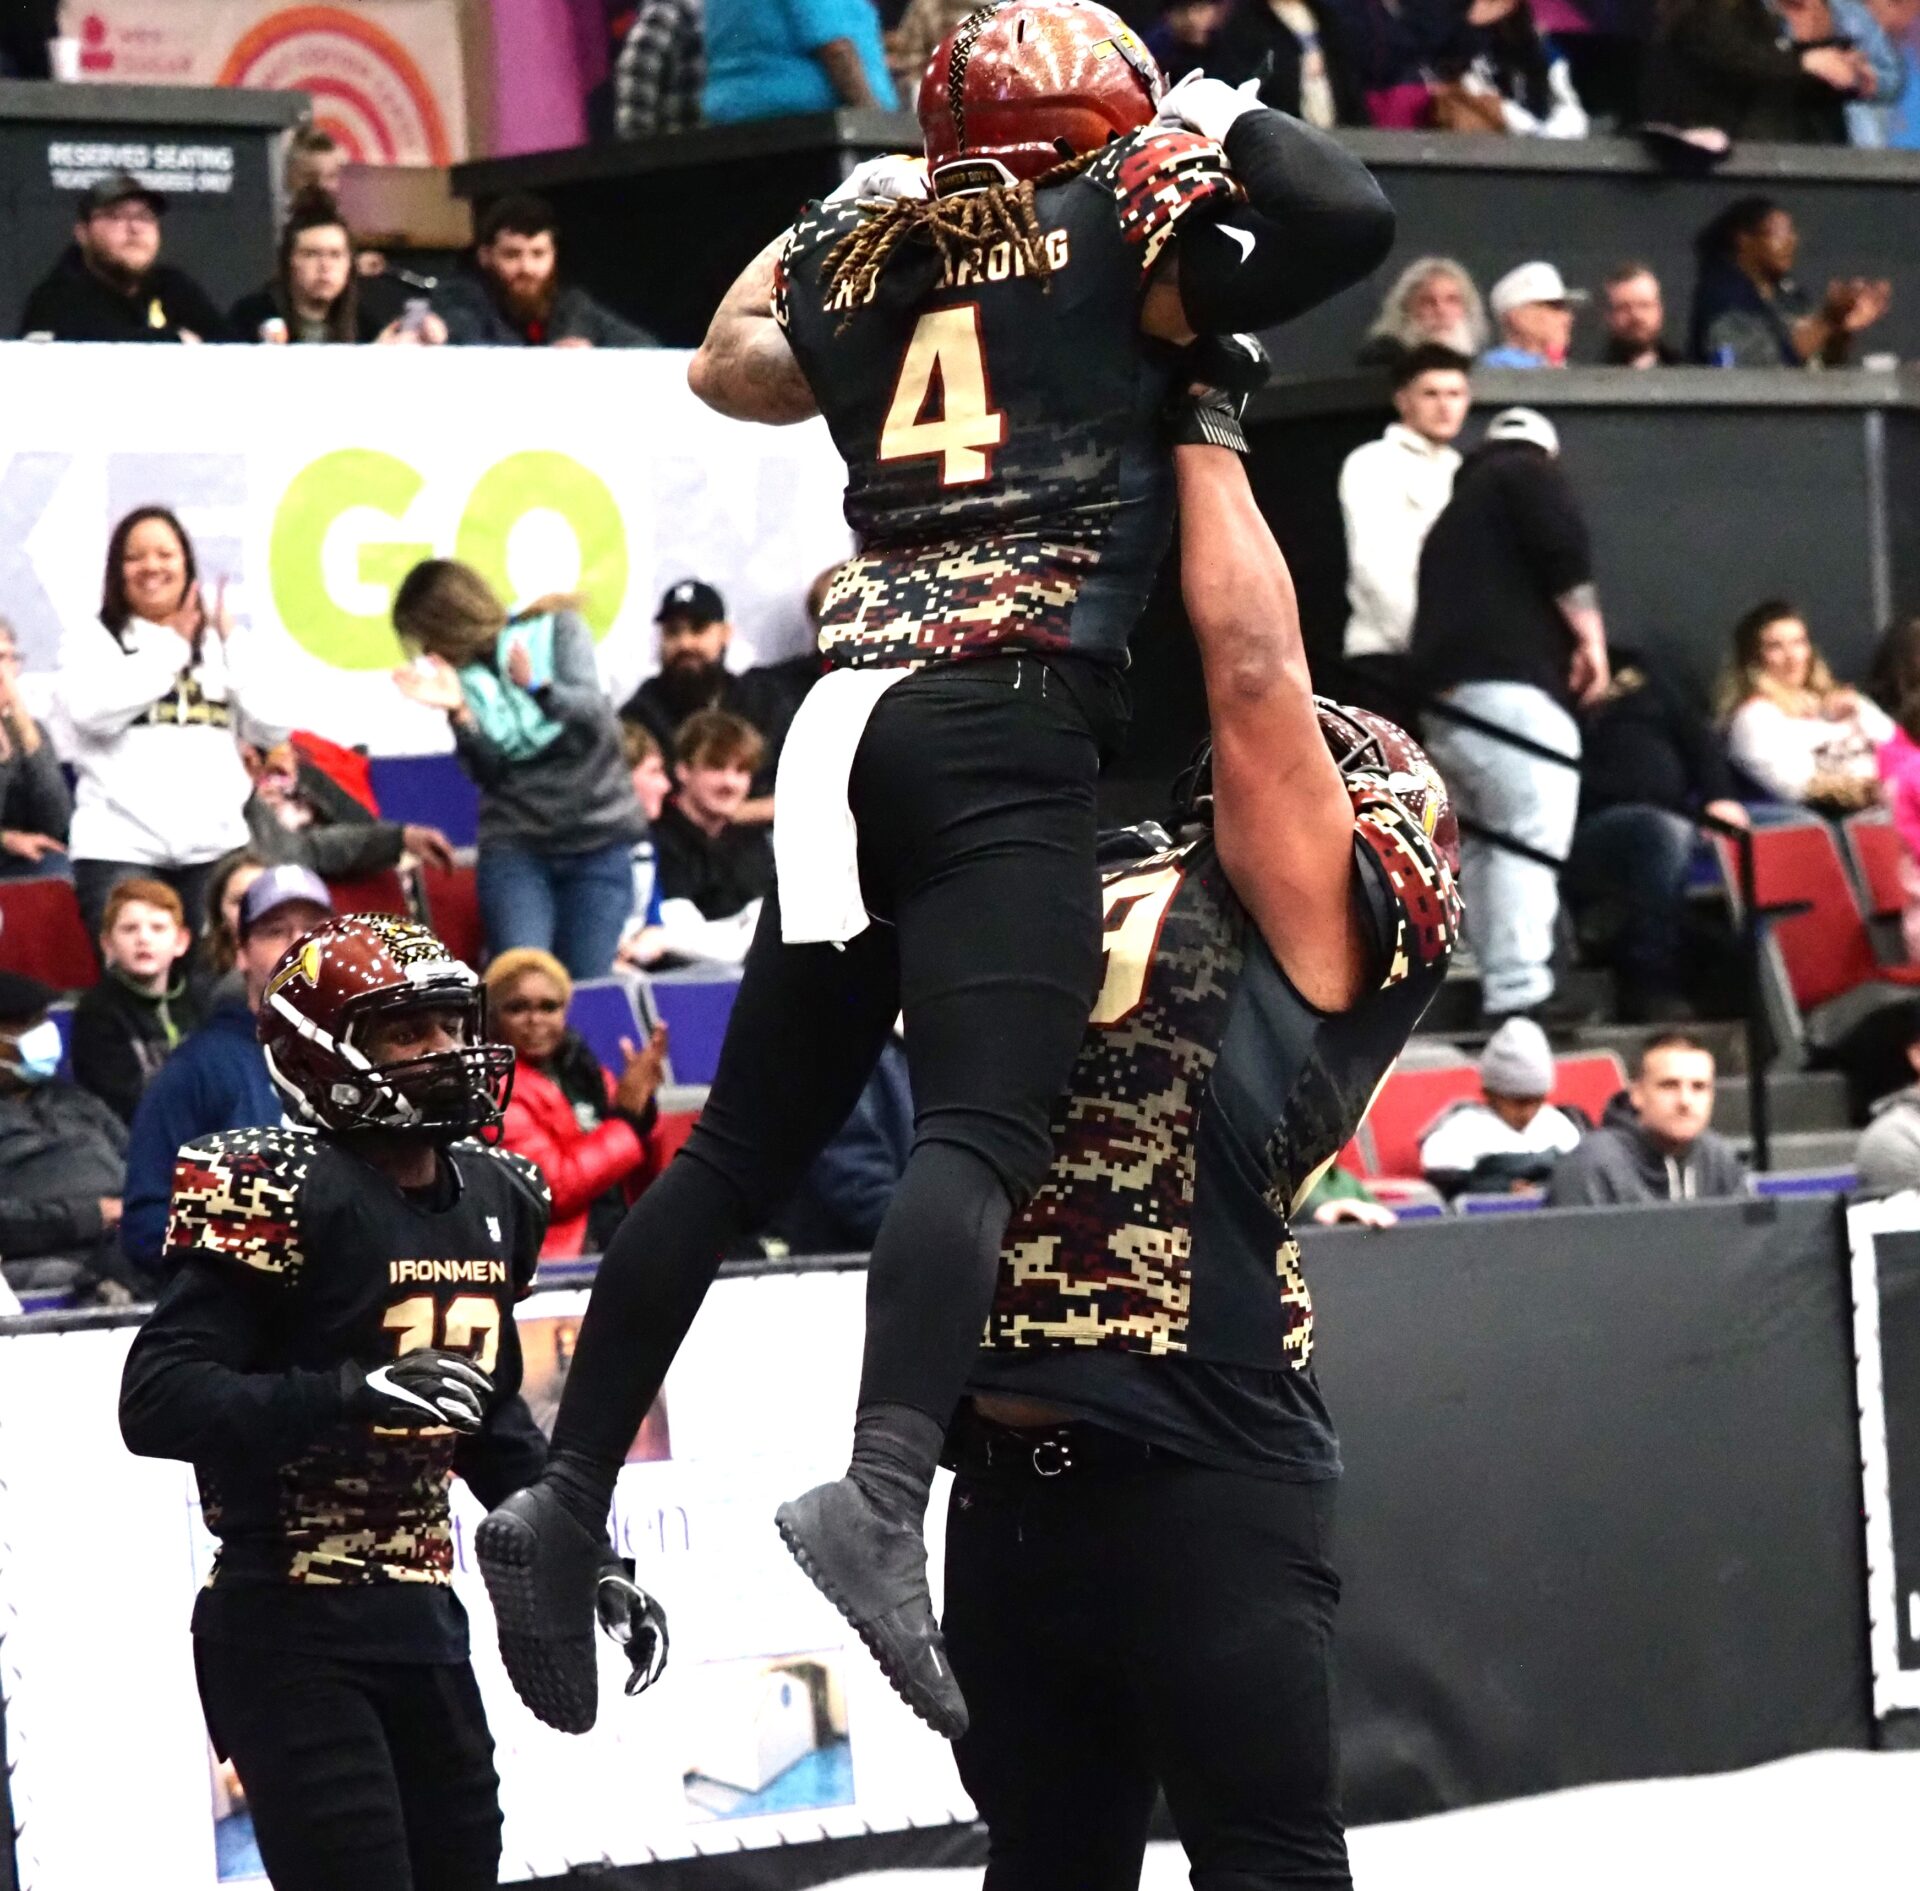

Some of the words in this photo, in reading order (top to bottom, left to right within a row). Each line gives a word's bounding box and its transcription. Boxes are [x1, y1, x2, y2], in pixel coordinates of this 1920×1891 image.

[48, 143, 149, 168] RESERVED
[153, 145, 234, 171] SEATING
[877, 302, 1006, 487] 4
[389, 1260, 507, 1284] IRONMEN
